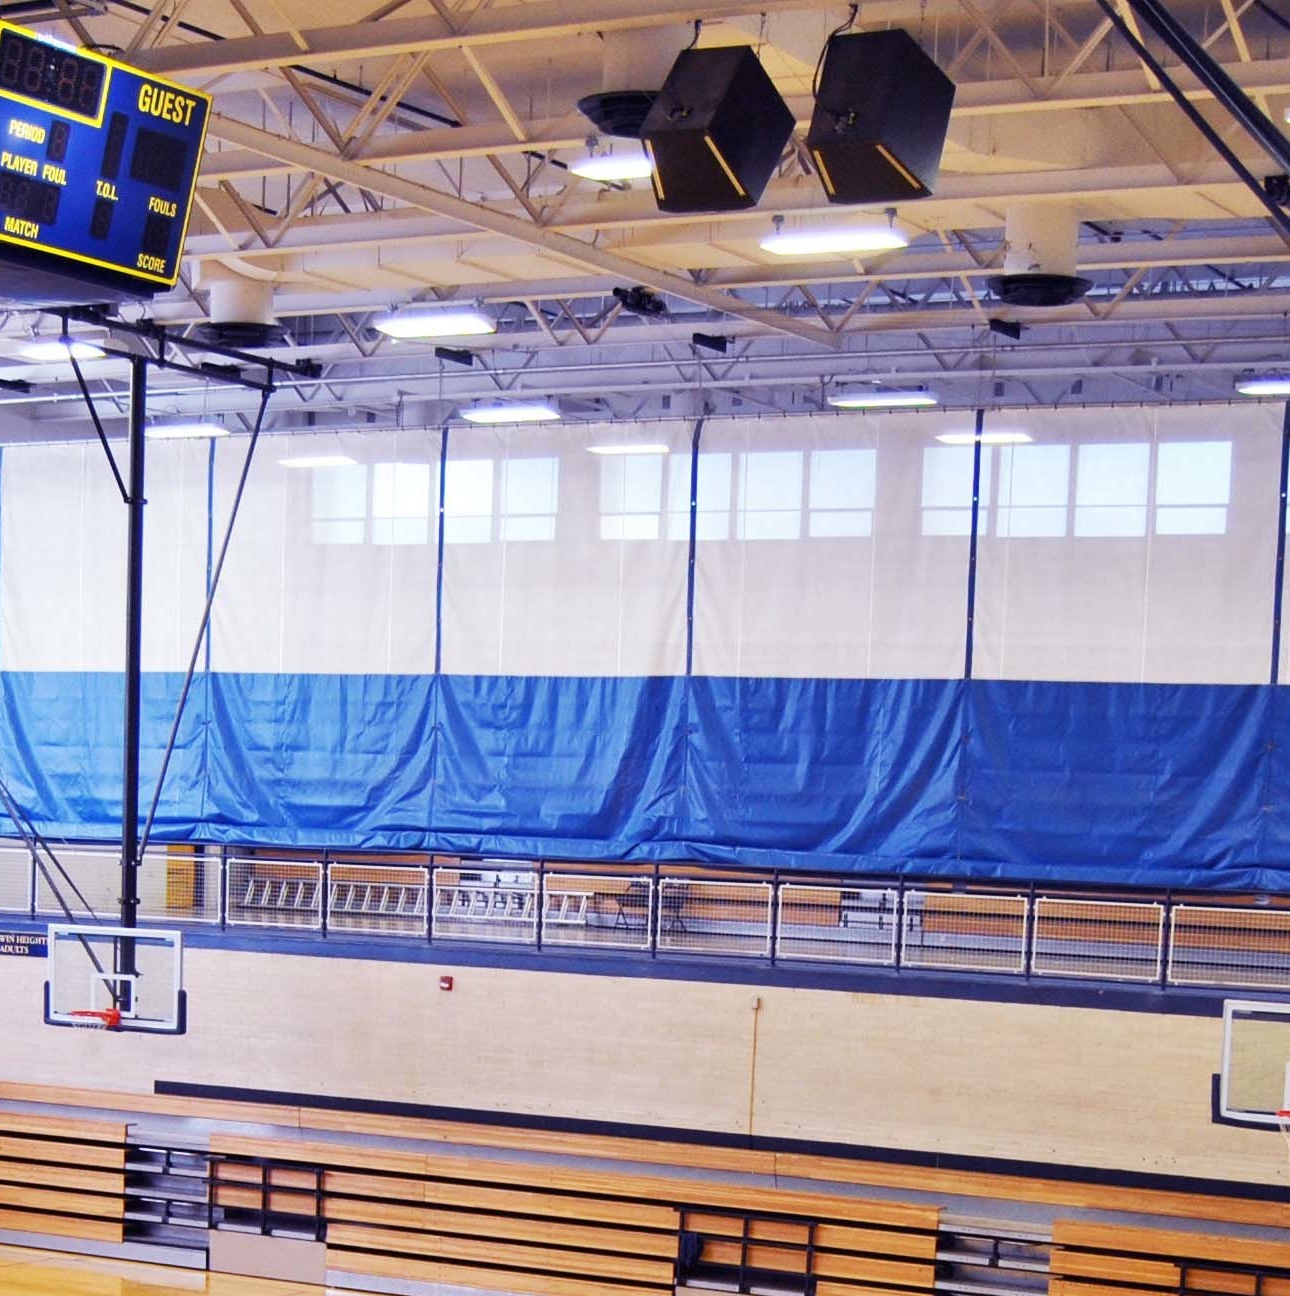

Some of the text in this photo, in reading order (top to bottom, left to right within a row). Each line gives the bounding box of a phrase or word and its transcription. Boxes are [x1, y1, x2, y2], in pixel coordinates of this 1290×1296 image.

[137, 84, 197, 127] GUEST
[9, 119, 46, 144] PERIOD
[0, 152, 67, 186] PLAYER FOUL
[148, 196, 177, 218] FOULS
[4, 216, 39, 239] MATCH
[136, 253, 166, 274] SCORE
[0, 944, 29, 954] ADULTS
